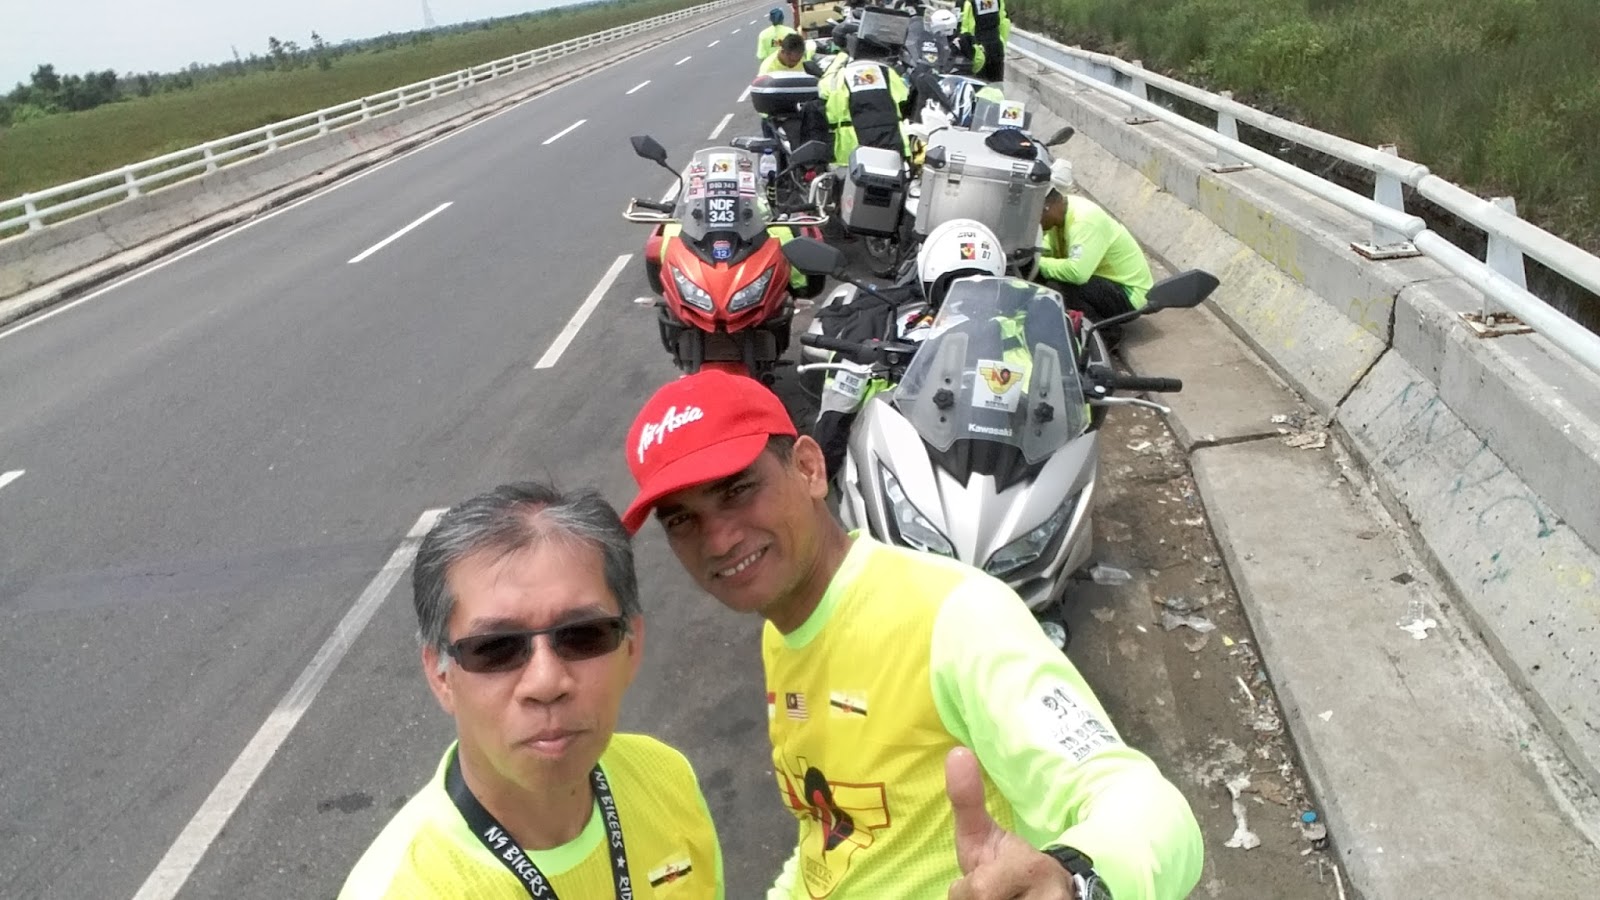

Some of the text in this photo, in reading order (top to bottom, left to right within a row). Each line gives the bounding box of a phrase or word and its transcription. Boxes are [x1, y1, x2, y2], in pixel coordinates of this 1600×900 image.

[709, 199, 735, 211] NDF
[709, 211, 735, 222] 343
[968, 423, 1013, 437] Kawasaki
[601, 796, 623, 849] BIKERS
[502, 844, 548, 898] BIKERS
